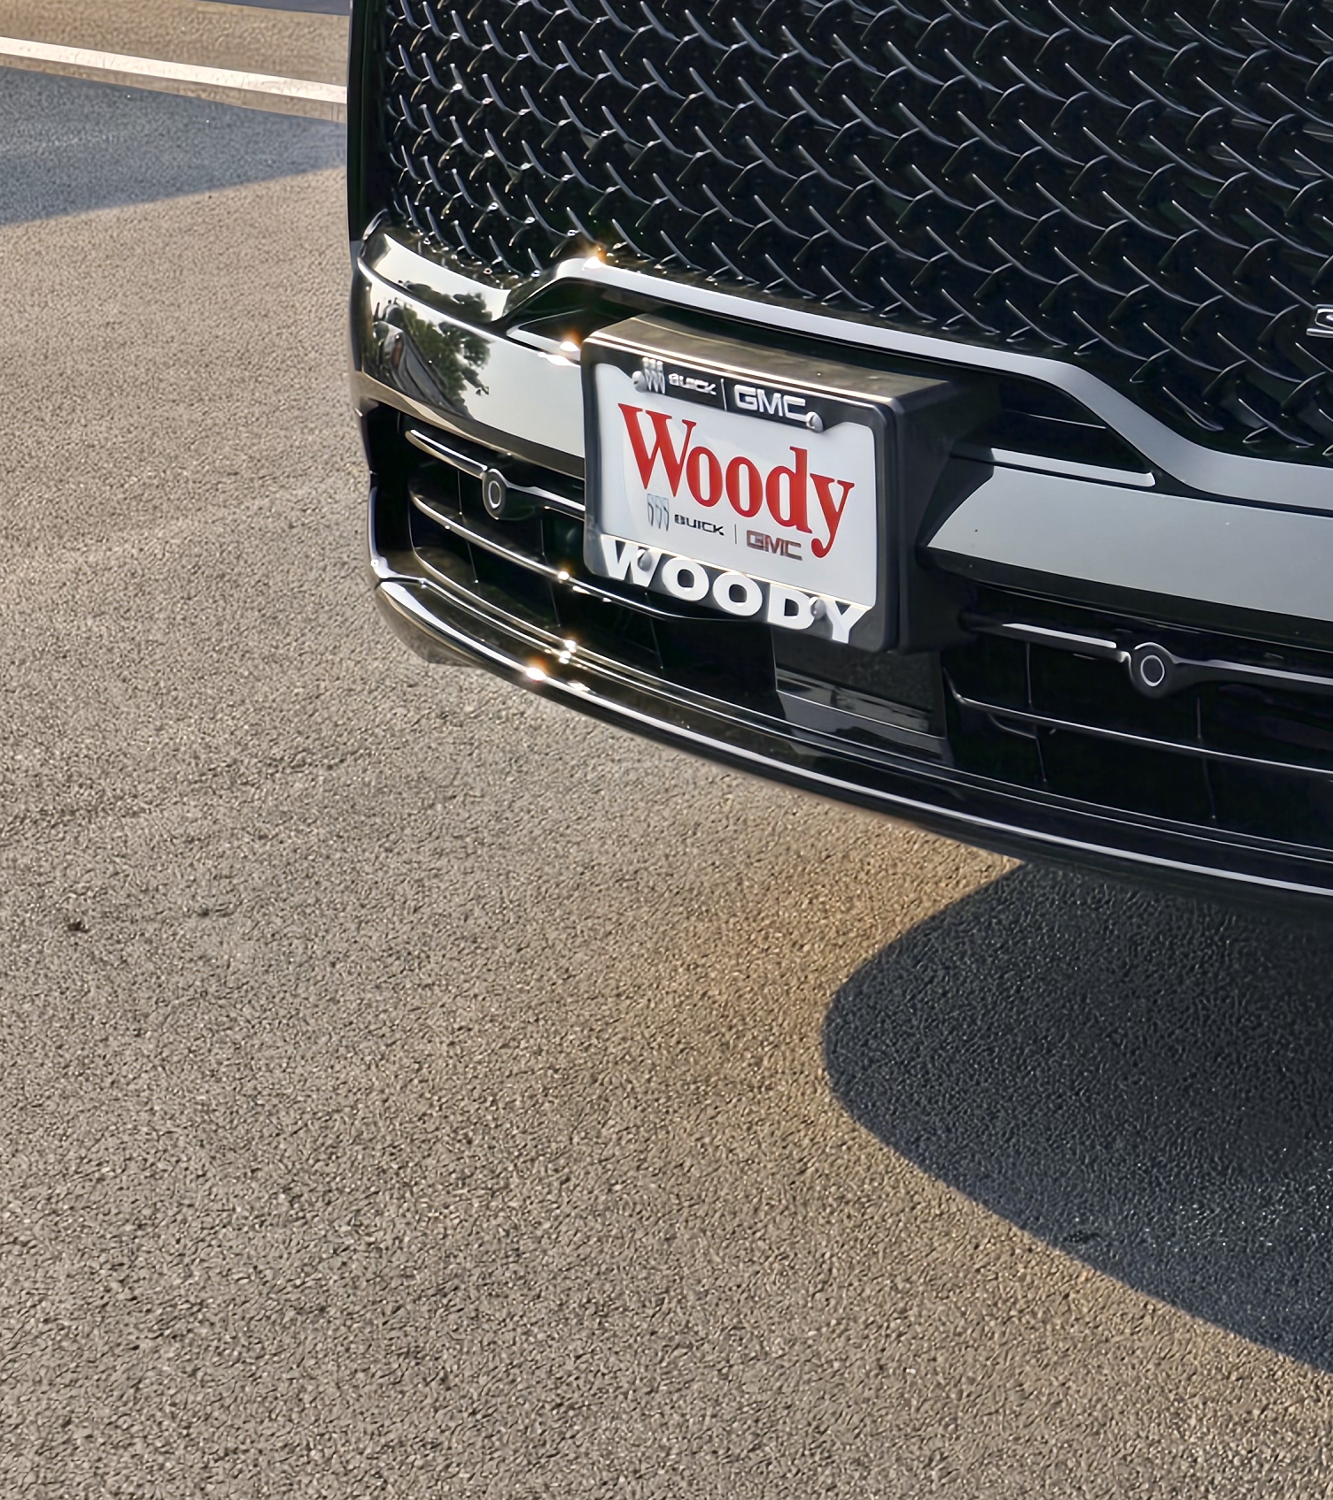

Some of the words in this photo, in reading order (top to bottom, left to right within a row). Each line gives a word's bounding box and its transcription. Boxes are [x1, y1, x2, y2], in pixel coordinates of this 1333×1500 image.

[668, 372, 717, 396] BUICK
[734, 384, 807, 423] GMC
[618, 403, 855, 558] Woody
[674, 514, 725, 536] BUICK
[746, 529, 803, 561] GMC
[601, 534, 872, 644] WOODY
